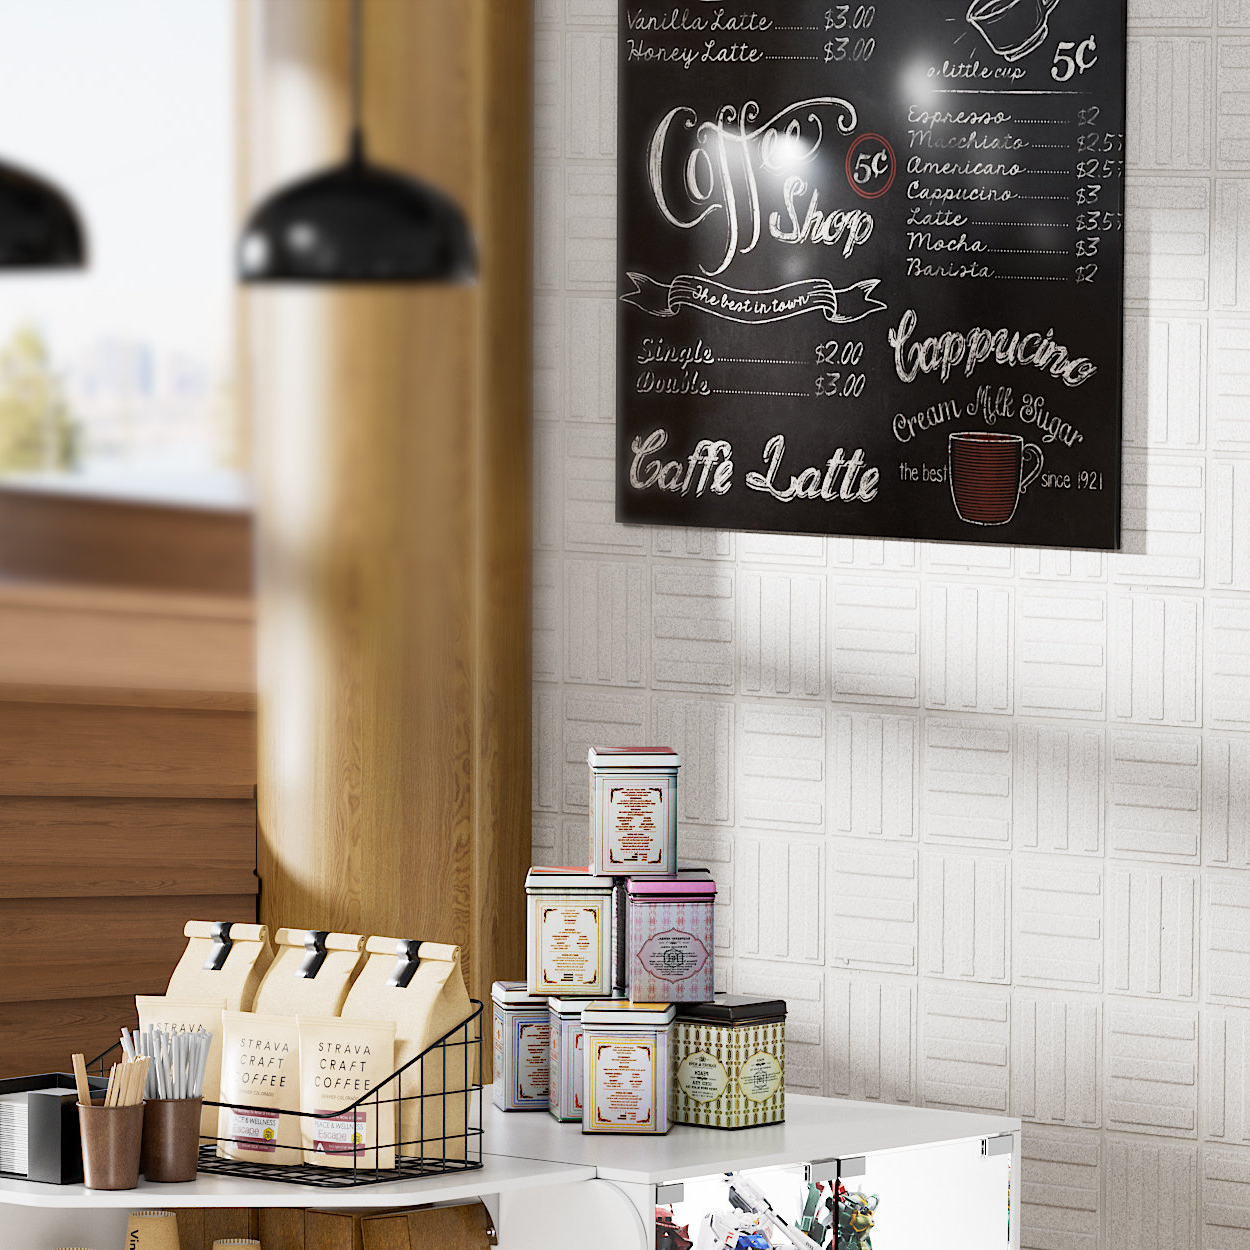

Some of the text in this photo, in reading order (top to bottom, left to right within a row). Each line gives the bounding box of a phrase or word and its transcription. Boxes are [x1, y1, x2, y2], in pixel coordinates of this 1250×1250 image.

[627, 5, 876, 31] Vanilla Latte $3.00
[627, 37, 876, 69] Honey Latte $3.00
[942, 60, 994, 79] little
[995, 65, 1027, 85] cup
[907, 104, 1100, 126] Espresso $2
[908, 130, 1030, 151] Macchiato
[906, 156, 1027, 176] Americano
[906, 180, 1102, 206] Cappucino $3
[769, 175, 875, 259] Shop
[906, 207, 968, 227] Latte
[906, 232, 1100, 257] Mocha $3
[906, 258, 1098, 284] Barista $2
[693, 285, 810, 314] The best in town
[637, 338, 864, 370] Single $2.00
[888, 309, 1097, 388] Cappucino
[636, 369, 866, 398] Double $3.00
[892, 385, 1084, 448] Cream Milk Sugar
[745, 434, 880, 503] Latte
[899, 463, 1103, 490] the best since 1921
[240, 1038, 289, 1053] STRAVA
[318, 1042, 371, 1056] STRAVA
[240, 1054, 284, 1069] CRAFT
[319, 1058, 367, 1072] CRAFT
[238, 1072, 286, 1087] OFFEE
[314, 1075, 370, 1091] COFFEE
